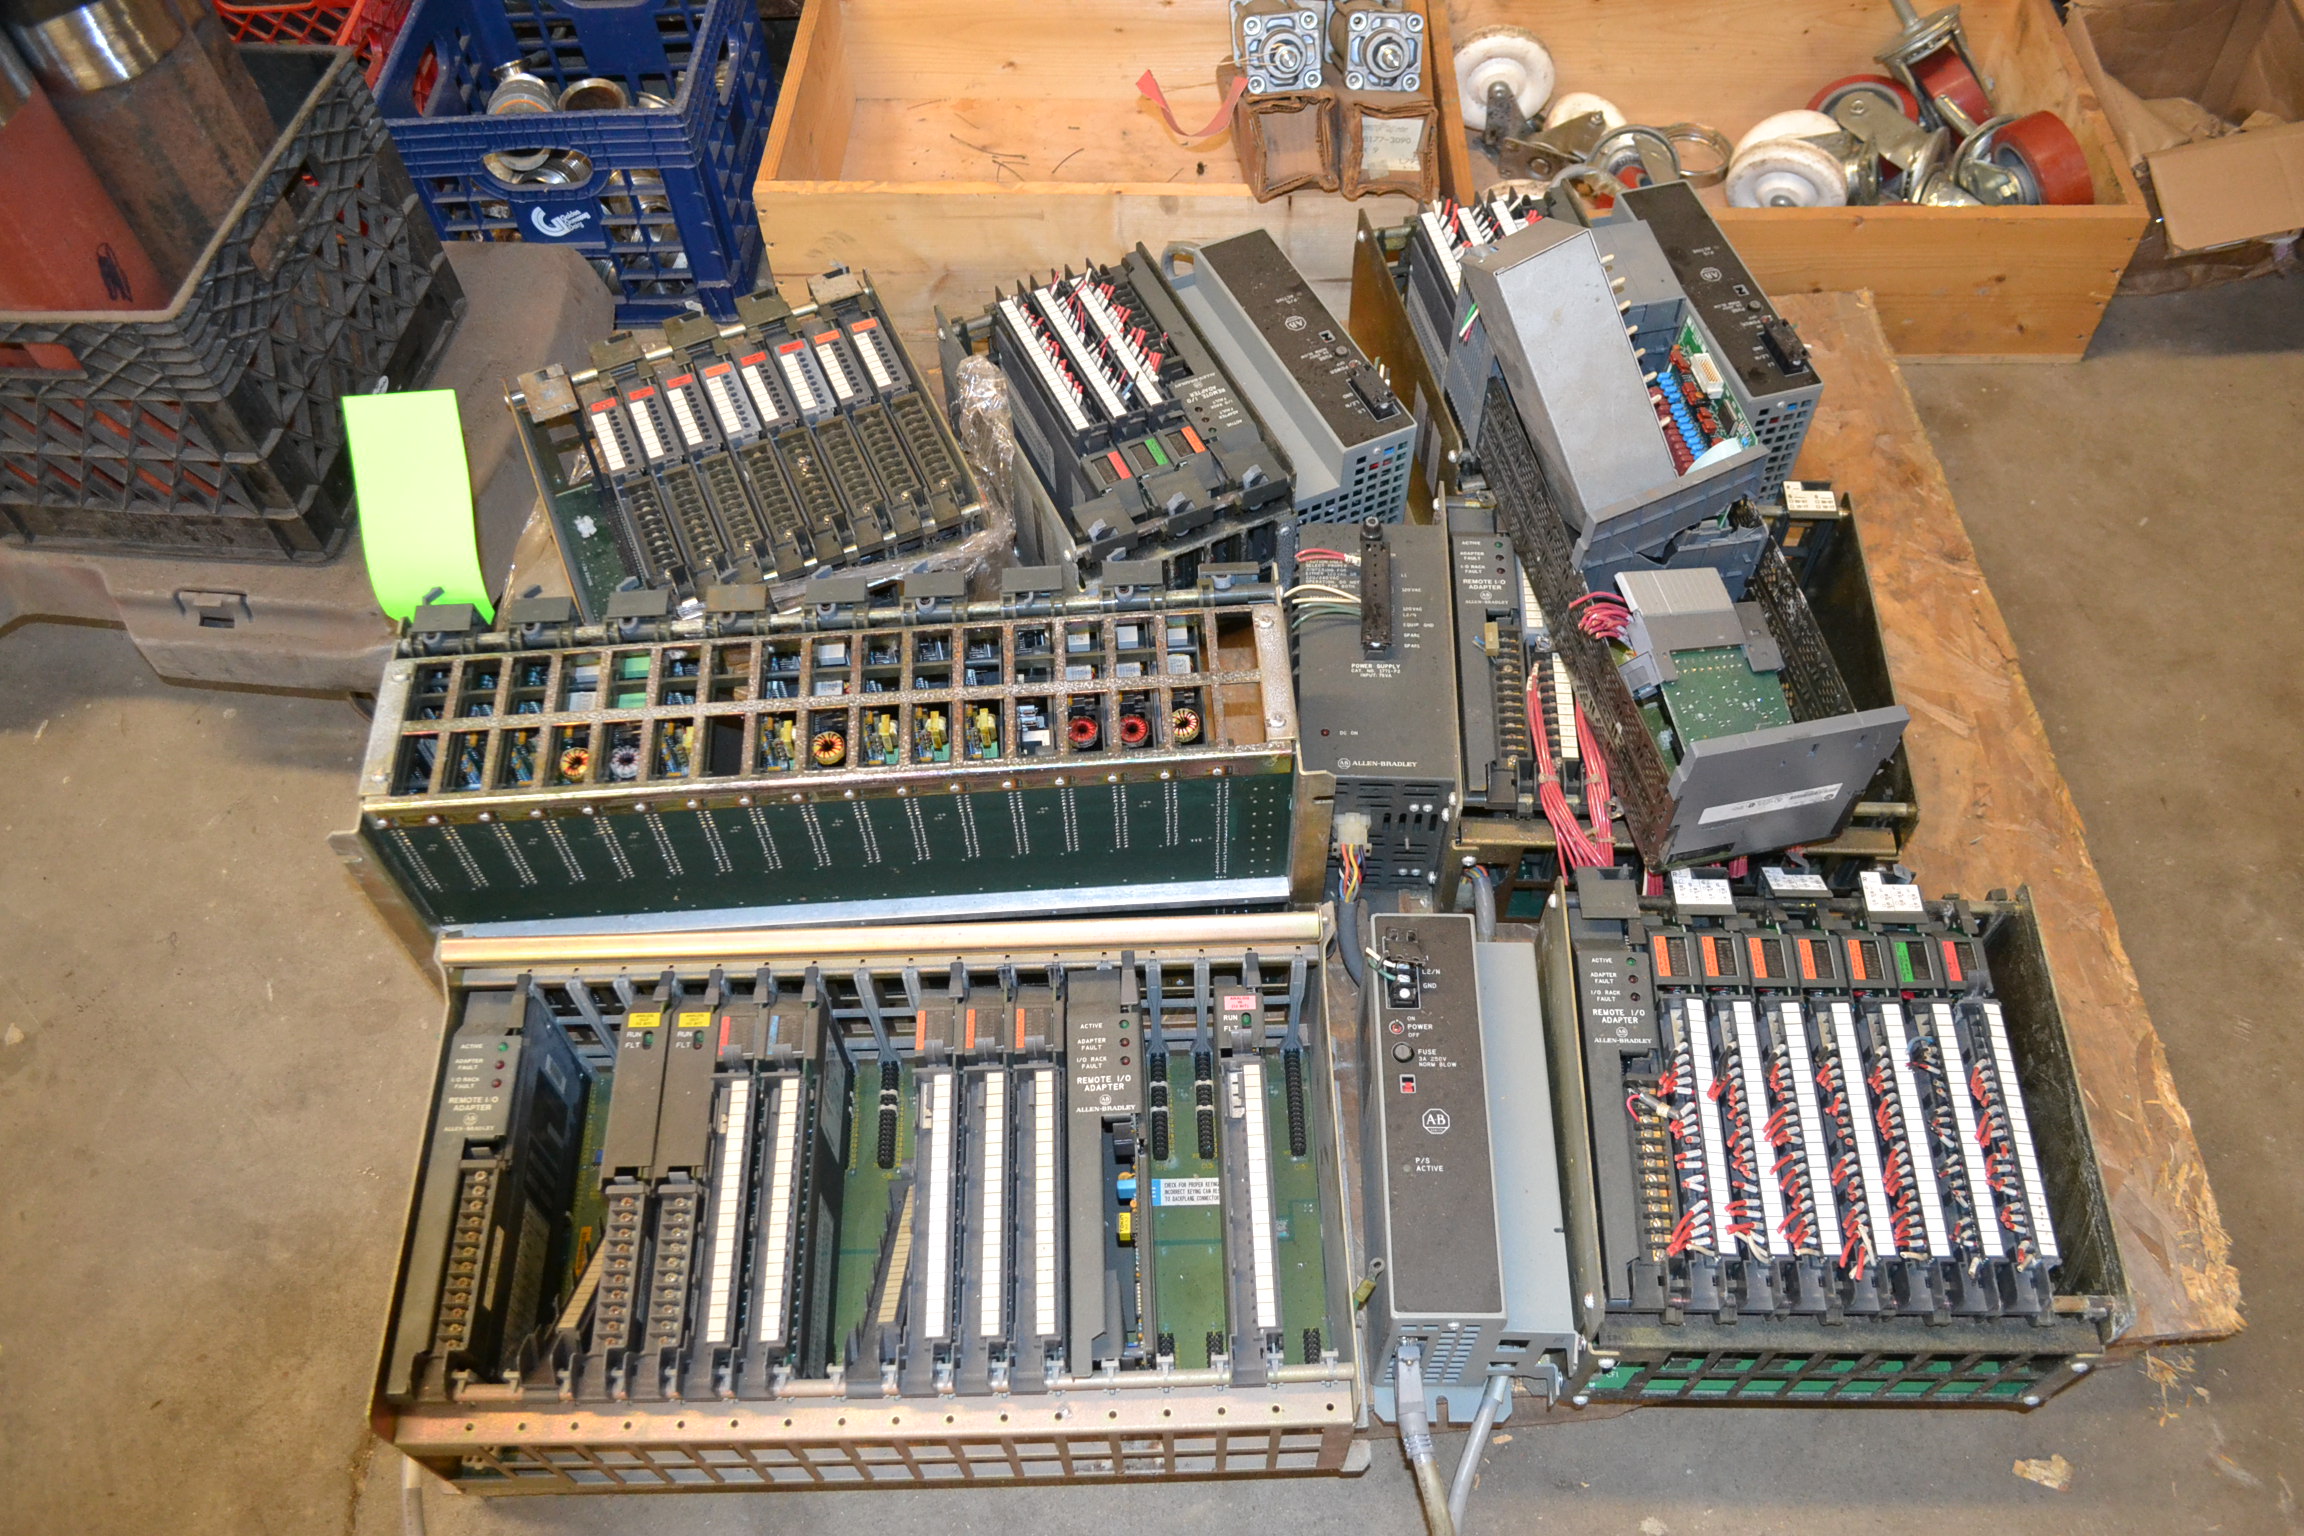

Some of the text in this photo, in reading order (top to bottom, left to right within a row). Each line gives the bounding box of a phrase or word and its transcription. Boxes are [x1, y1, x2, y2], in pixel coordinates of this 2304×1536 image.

[1077, 1037, 1106, 1045] ADAPTER
[1076, 1074, 1132, 1084] REMOTE I/O
[1084, 1083, 1125, 1092] ADAPTER
[1076, 1104, 1136, 1113] ALLEN-BRADLEY
